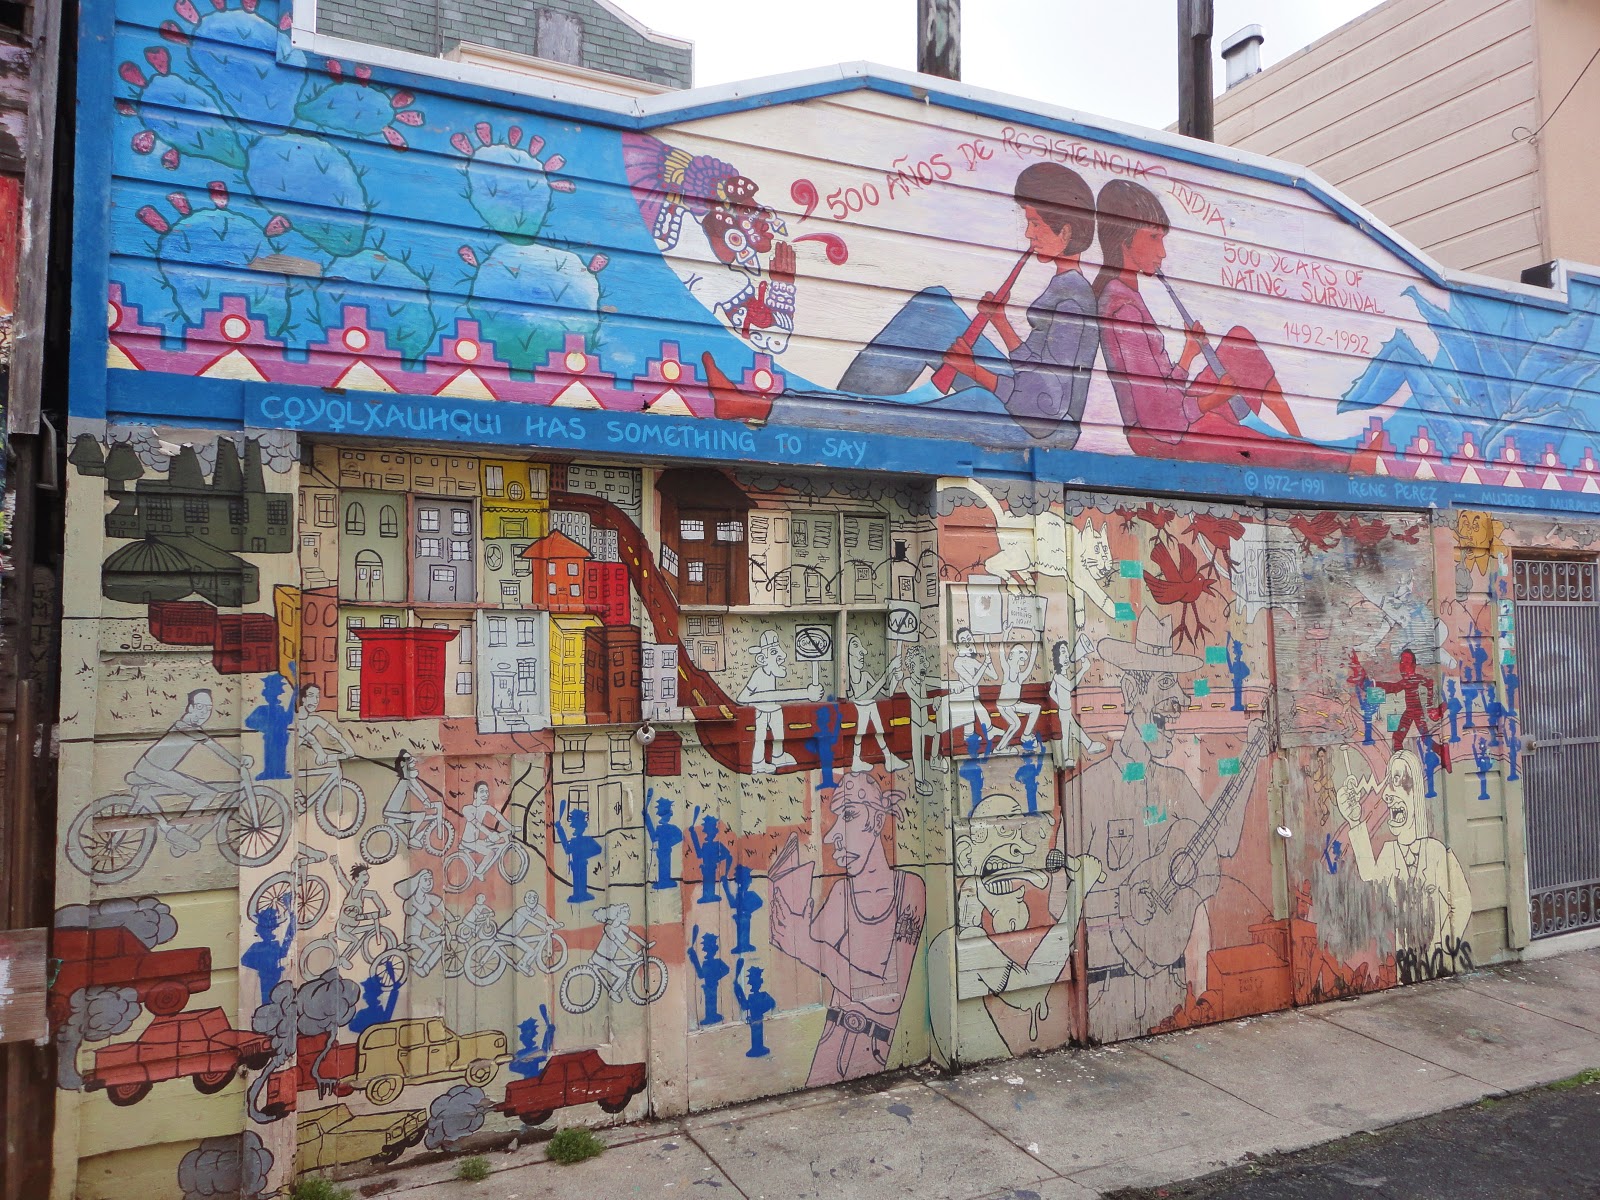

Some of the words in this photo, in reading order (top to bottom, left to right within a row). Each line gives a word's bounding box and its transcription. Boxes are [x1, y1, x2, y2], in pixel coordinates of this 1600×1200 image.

[826, 183, 880, 220] 500
[886, 154, 952, 201] AÑOS
[957, 139, 994, 171] DE
[1000, 126, 1168, 181] RESISTENCIA
[1166, 177, 1227, 237] INDIA
[1223, 242, 1261, 268] 500
[1267, 252, 1338, 287] YEARS
[1345, 269, 1364, 288] OF
[1221, 265, 1287, 297] NATIVE
[1301, 281, 1386, 314] SURVIVAL
[260, 396, 501, 437] COYOLXAUHQUI
[526, 415, 586, 440] HAS
[607, 420, 755, 452] SOMETHING
[775, 433, 802, 455] TO
[821, 437, 866, 465] SAY
[1263, 474, 1325, 495] 1972-1991
[1347, 479, 1387, 499] IRENE
[1393, 482, 1438, 503] PEREZ
[1481, 491, 1536, 507] MUJERES
[890, 617, 915, 629] WAR
